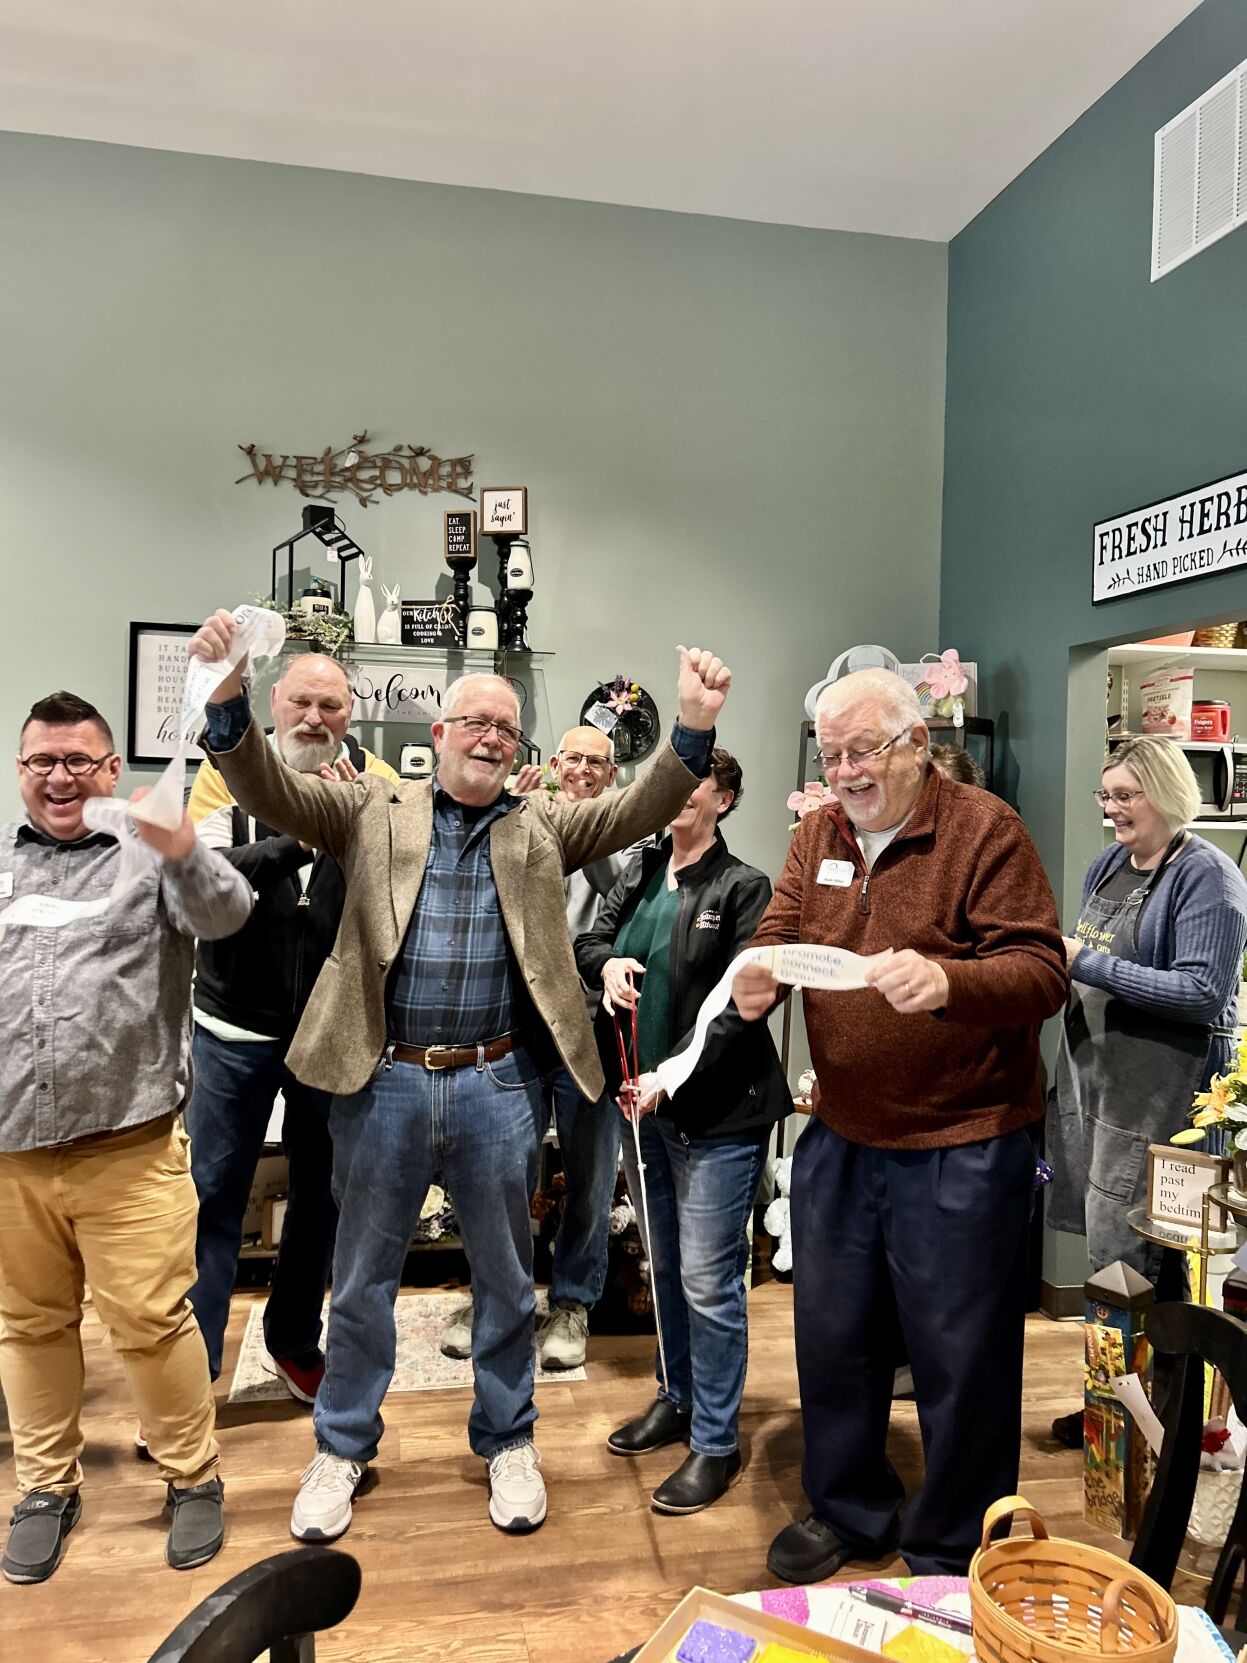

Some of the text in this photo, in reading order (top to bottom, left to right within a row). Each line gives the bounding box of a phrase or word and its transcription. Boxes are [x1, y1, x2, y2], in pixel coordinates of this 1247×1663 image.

[252, 453, 474, 494] WELCOME
[494, 498, 511, 515] just
[1098, 511, 1169, 566] FRESH
[1137, 547, 1214, 585] HAND PICKED
[412, 630, 437, 638] COOKING
[158, 644, 168, 652] IT
[157, 686, 176, 694] BUT
[1161, 1159, 1196, 1175] I read
[1160, 1175, 1185, 1187] past
[1160, 1190, 1179, 1203] my
[1159, 1201, 1201, 1219] bedtim
[1083, 1471, 1106, 1489] the
[1084, 1490, 1123, 1518] bridge
